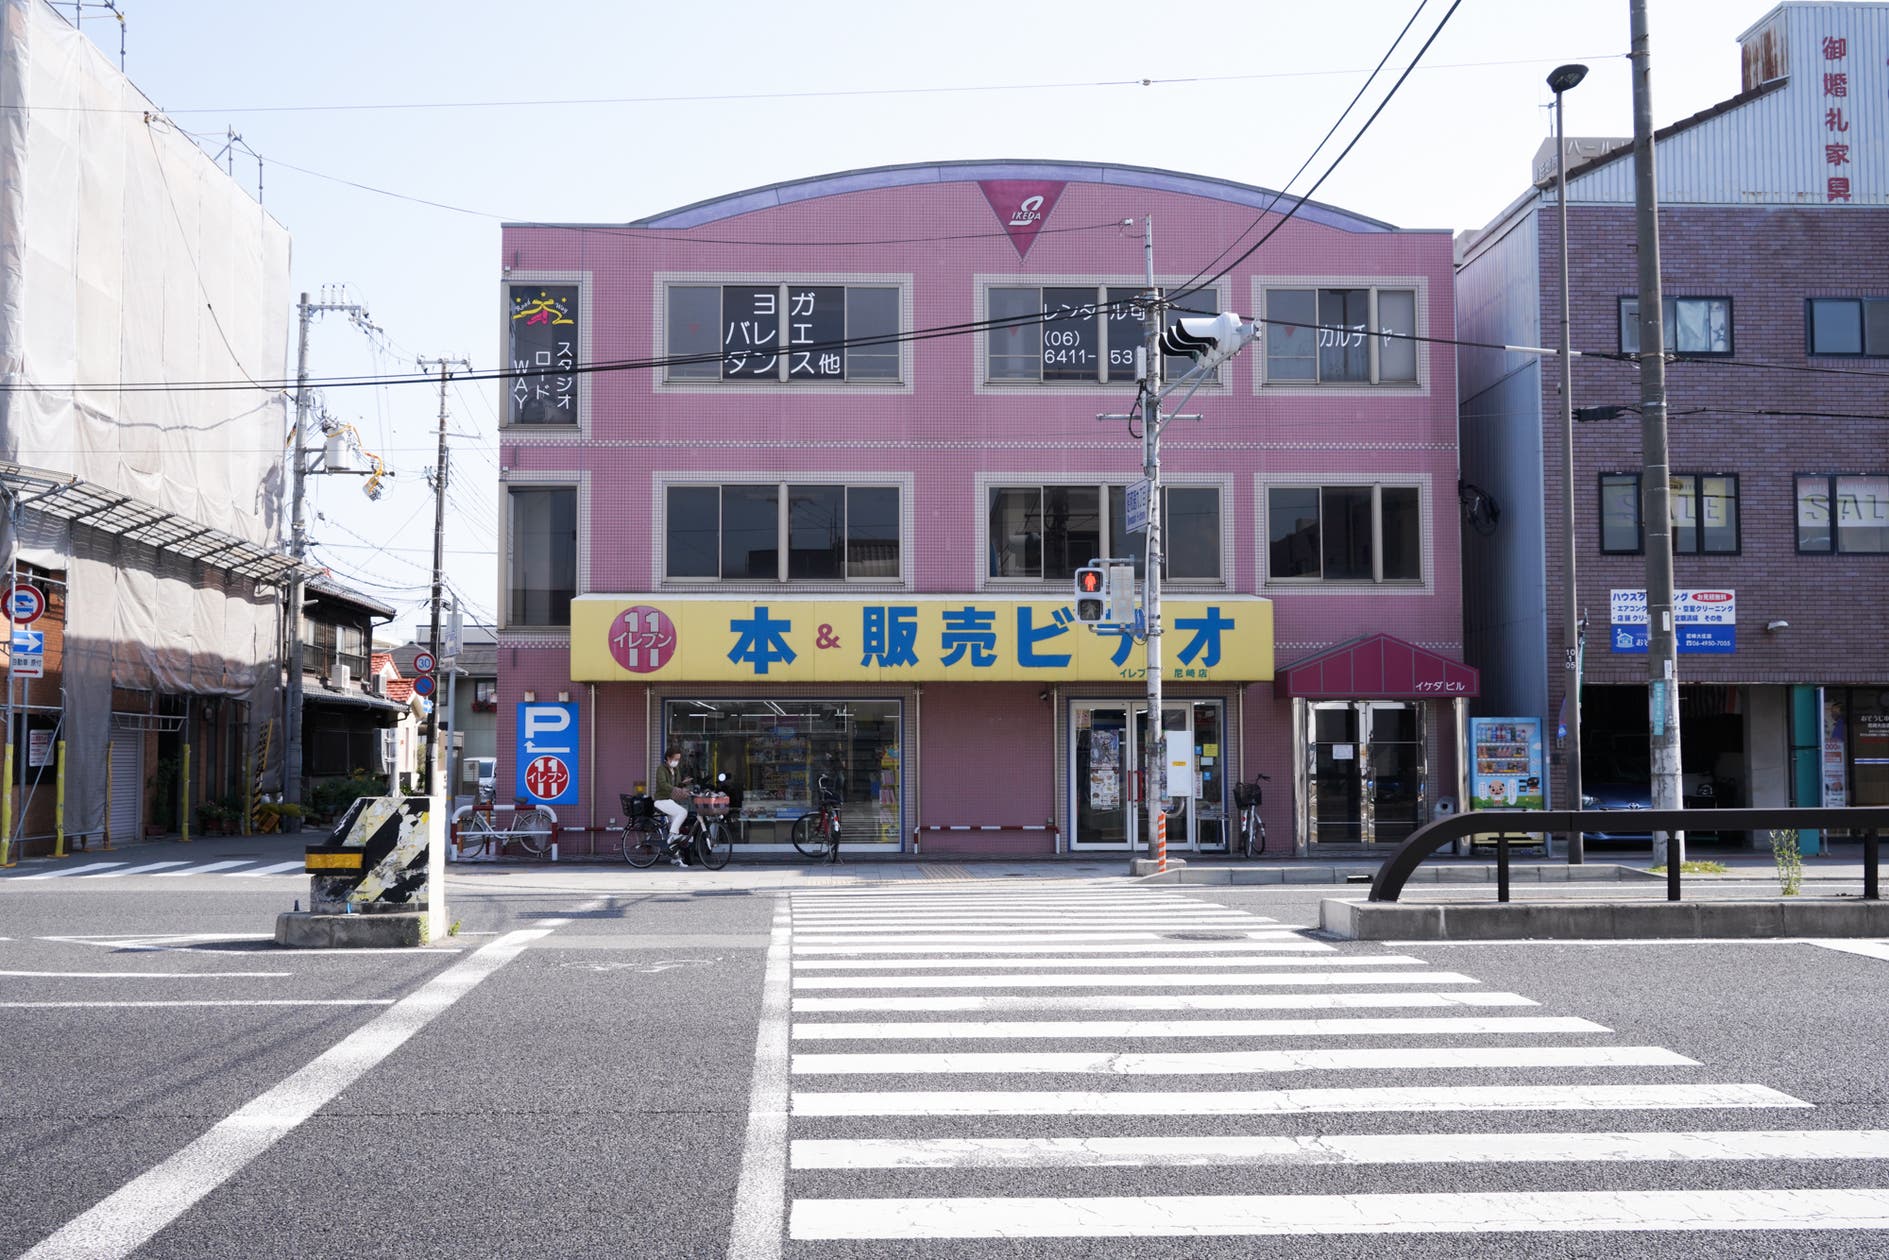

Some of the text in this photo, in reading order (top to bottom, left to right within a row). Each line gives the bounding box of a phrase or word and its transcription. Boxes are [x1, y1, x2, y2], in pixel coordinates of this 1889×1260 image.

[1822, 36, 1851, 202] 御婚礼家具
[1012, 211, 1041, 220] IKEDA
[753, 291, 815, 316] ヨガ
[1044, 330, 1080, 347] (06)
[1044, 349, 1133, 364] 6411-53
[535, 351, 551, 400] ロード
[556, 341, 573, 410] スタジオ
[514, 359, 529, 410] WAY
[613, 631, 672, 649] イレブン
[1566, 648, 1576, 656] 10
[418, 658, 432, 669] 30
[1174, 668, 1208, 678] 尼崎店
[525, 706, 571, 739] P
[527, 772, 567, 784] イレブン
